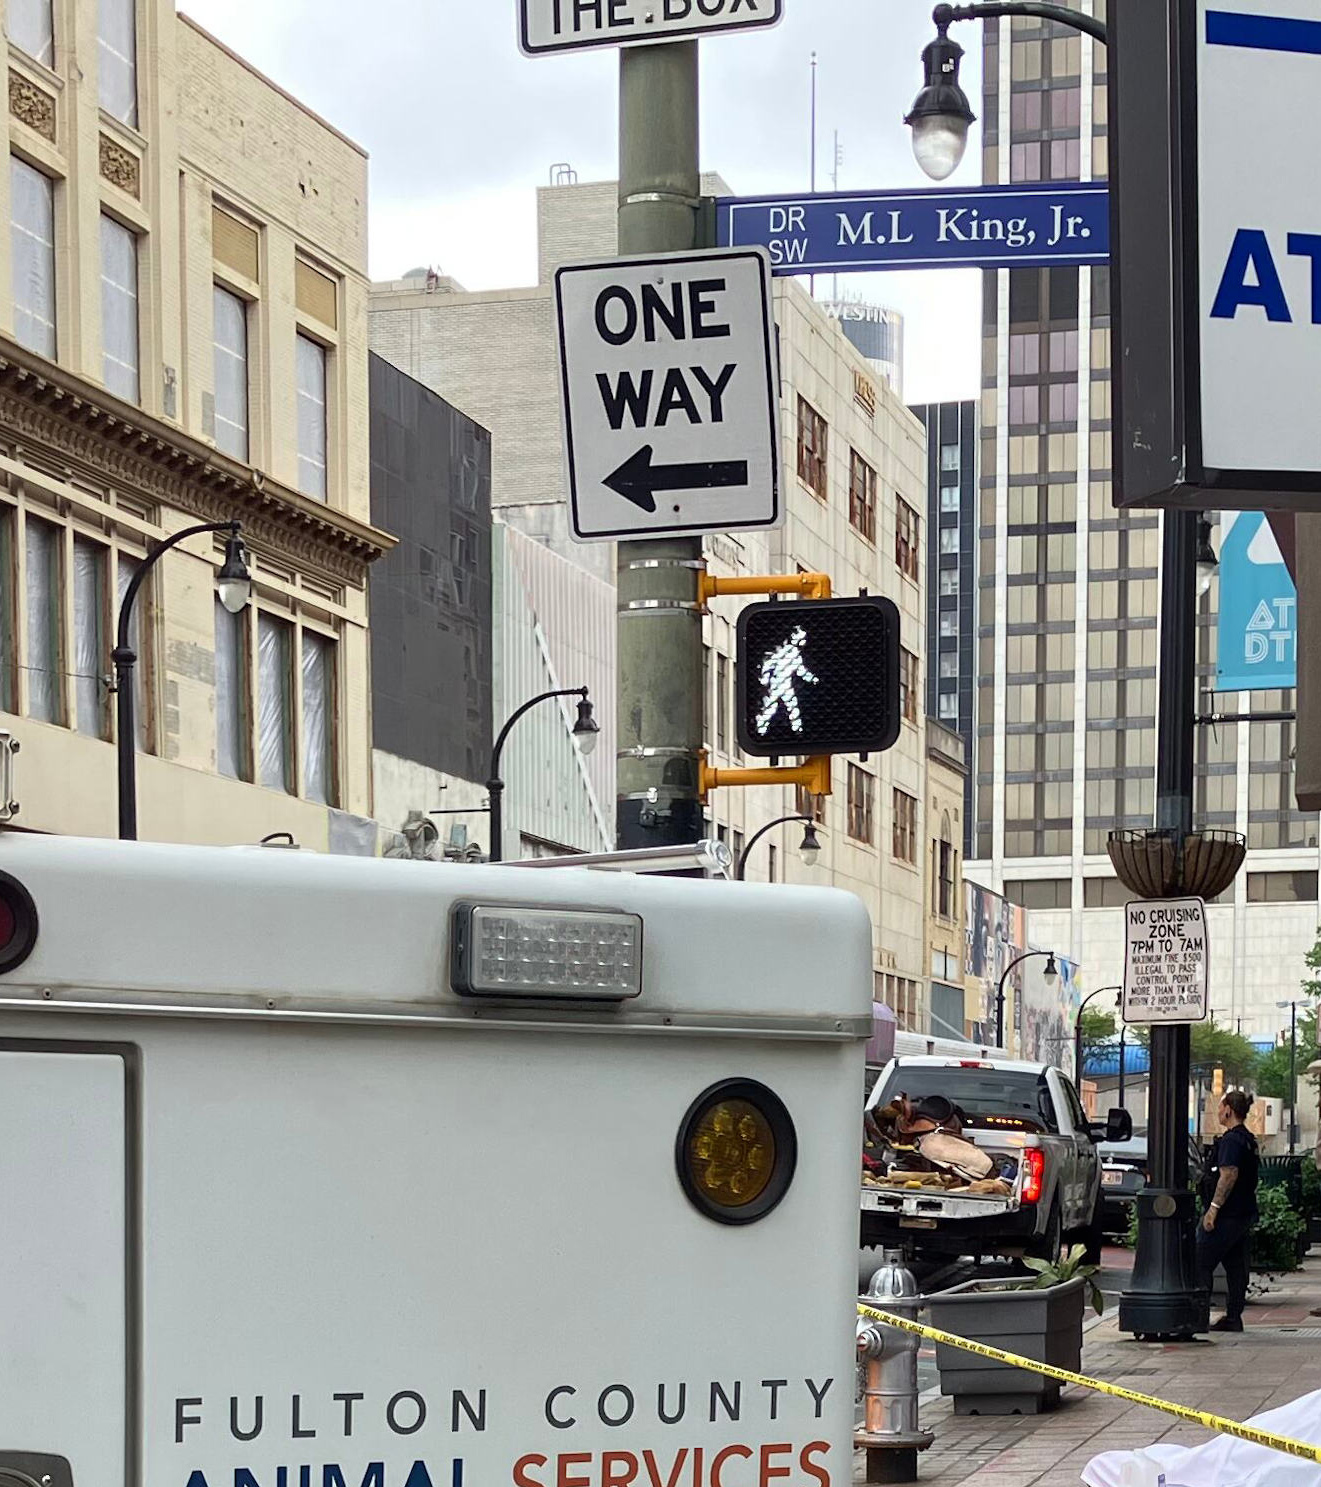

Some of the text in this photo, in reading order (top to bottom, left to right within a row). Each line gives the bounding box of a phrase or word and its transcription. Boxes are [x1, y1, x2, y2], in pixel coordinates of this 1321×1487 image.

[769, 206, 806, 233] DR
[836, 205, 1092, 248] M.L King, Jr.
[769, 237, 808, 265] SW
[593, 277, 733, 347] ONE
[821, 302, 890, 325] WESTIN
[595, 363, 738, 430] WAY
[1244, 631, 1297, 664] DT
[1130, 908, 1200, 925] NO CRUISING
[1149, 924, 1185, 938] ZONE
[1131, 938, 1203, 954] 7PM TO 7AM
[1131, 954, 1162, 964] MAXIMUM
[1165, 953, 1179, 963] FINE
[1134, 963, 1196, 975] ILLEGAL TO PASS
[1131, 986, 1151, 995] MORE
[1154, 985, 1173, 994] THAN
[1136, 974, 1194, 985] CONTROL POINT
[174, 1378, 835, 1443] FULTON COUNTY
